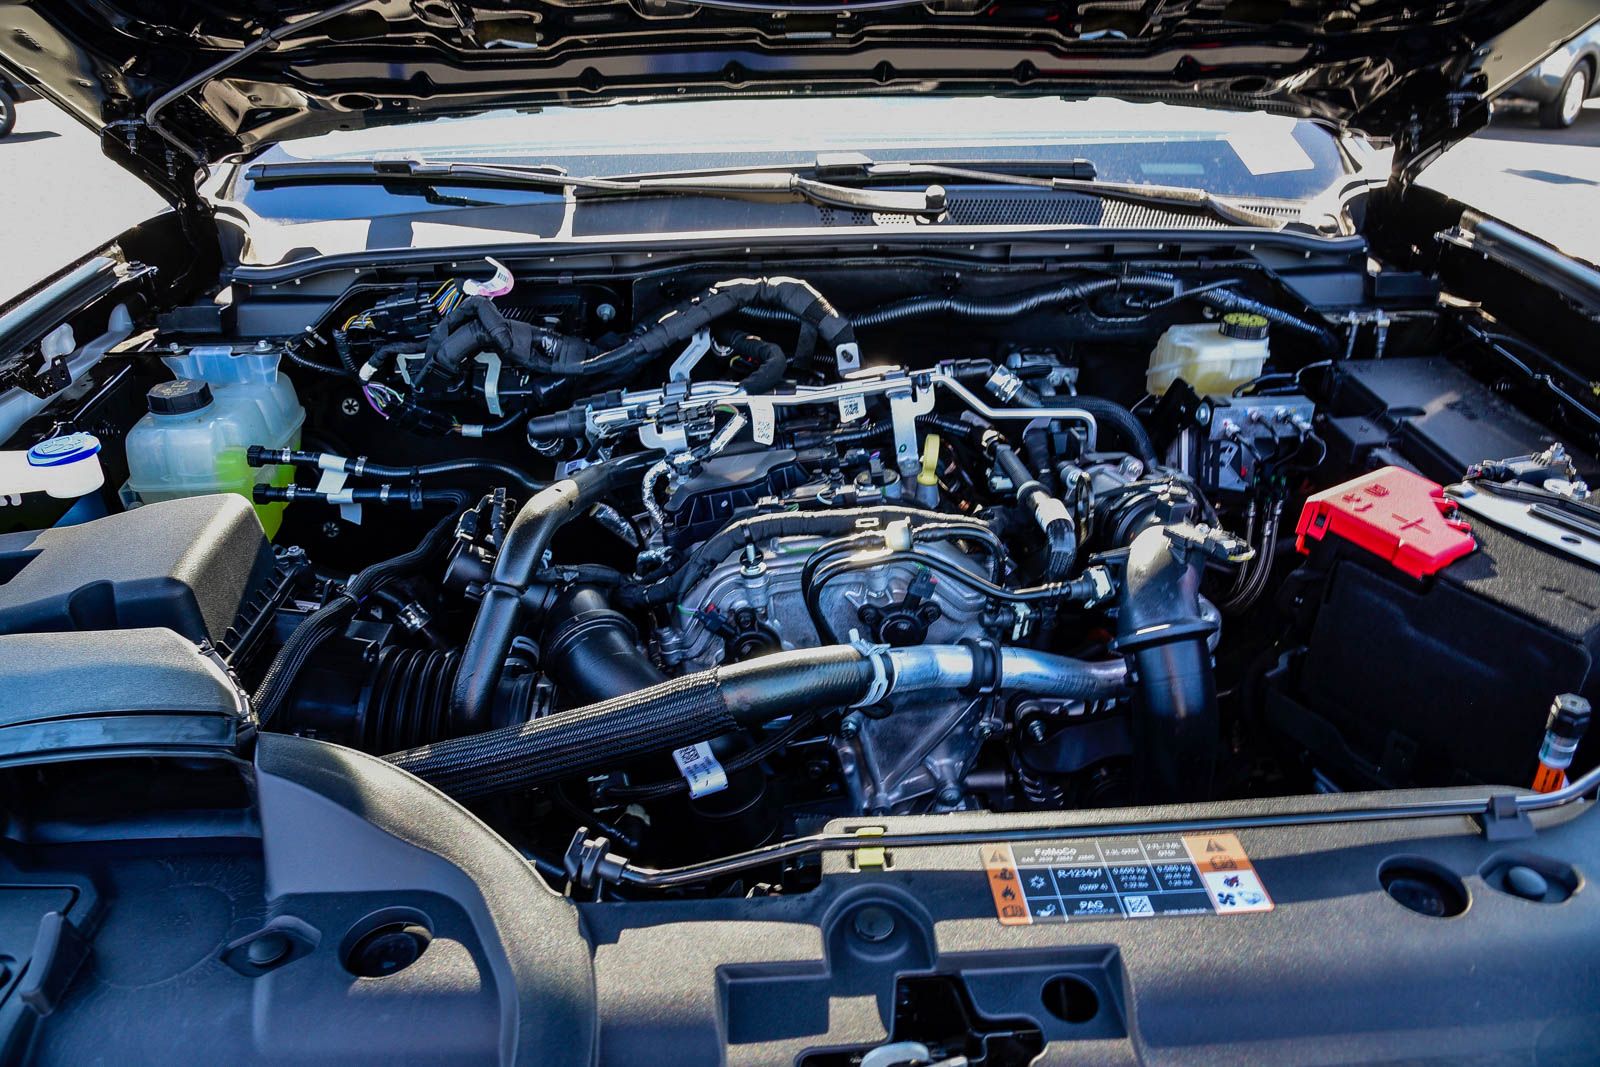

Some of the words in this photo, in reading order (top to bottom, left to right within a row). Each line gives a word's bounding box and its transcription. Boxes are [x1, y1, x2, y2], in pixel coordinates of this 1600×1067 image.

[1034, 847, 1077, 857] FoMoCo
[1057, 868, 1102, 878] R-1234yf
[1079, 900, 1105, 909] PAG
